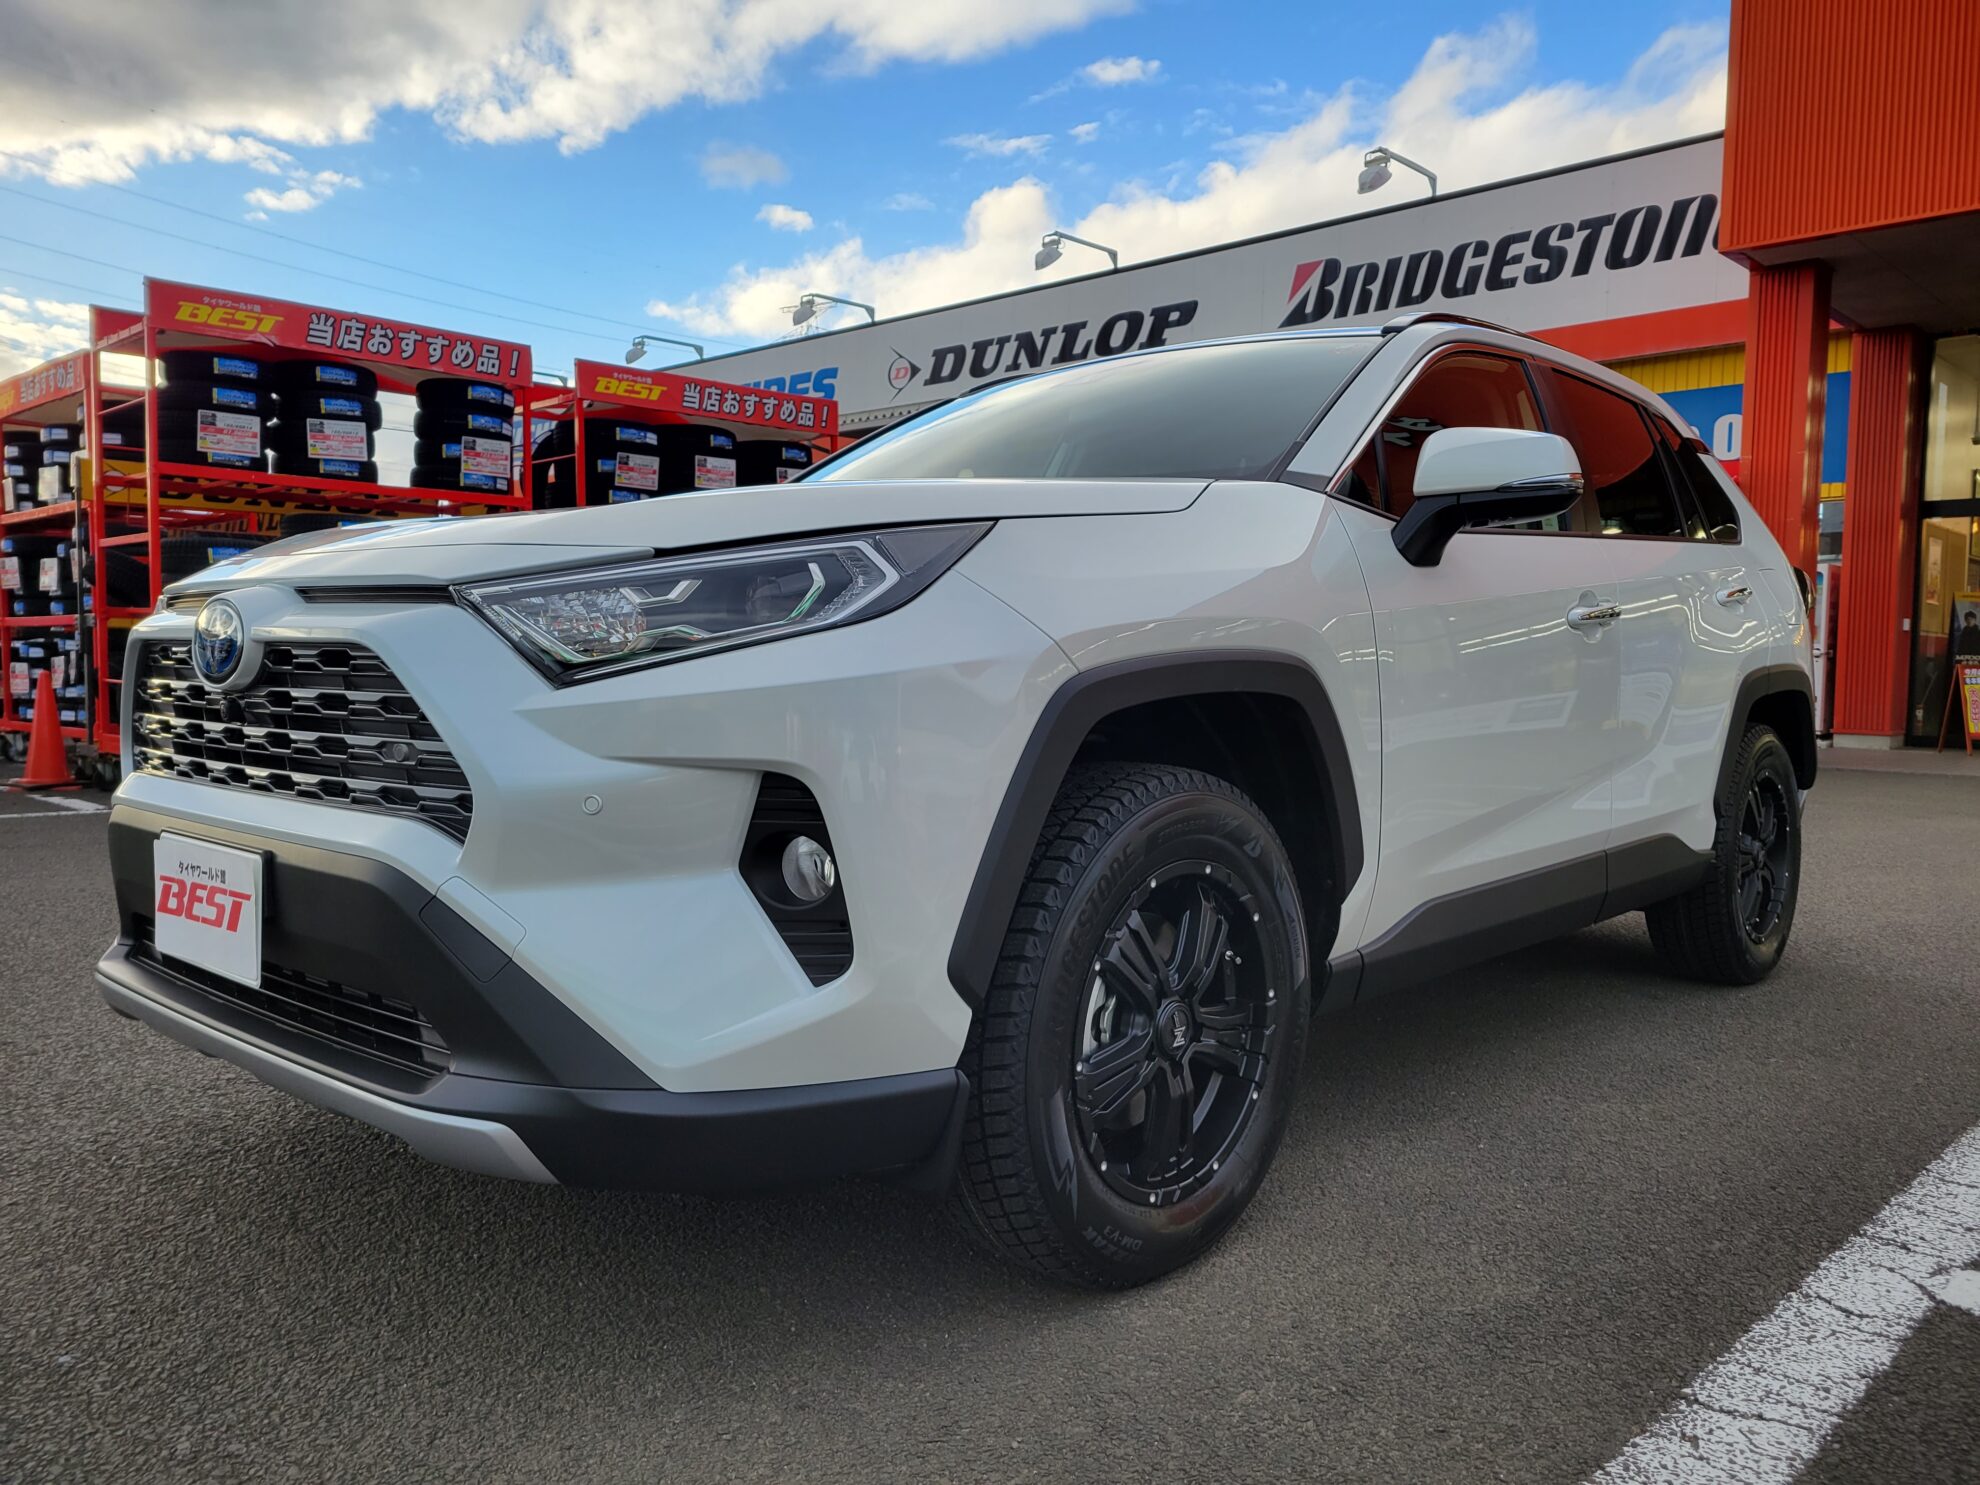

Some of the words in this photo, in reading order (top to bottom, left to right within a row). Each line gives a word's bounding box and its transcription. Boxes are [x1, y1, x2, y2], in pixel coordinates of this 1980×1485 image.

[1278, 194, 1719, 329] BRIDGESTON
[175, 301, 284, 333] BEST
[923, 299, 1199, 387] DUNLOP
[306, 312, 520, 377] 当店おすすめ品！
[595, 376, 668, 401] BEST
[682, 382, 829, 428] 当店おすすめ品！
[178, 861, 226, 884] タイヤワールド館
[157, 874, 253, 933] BEST
